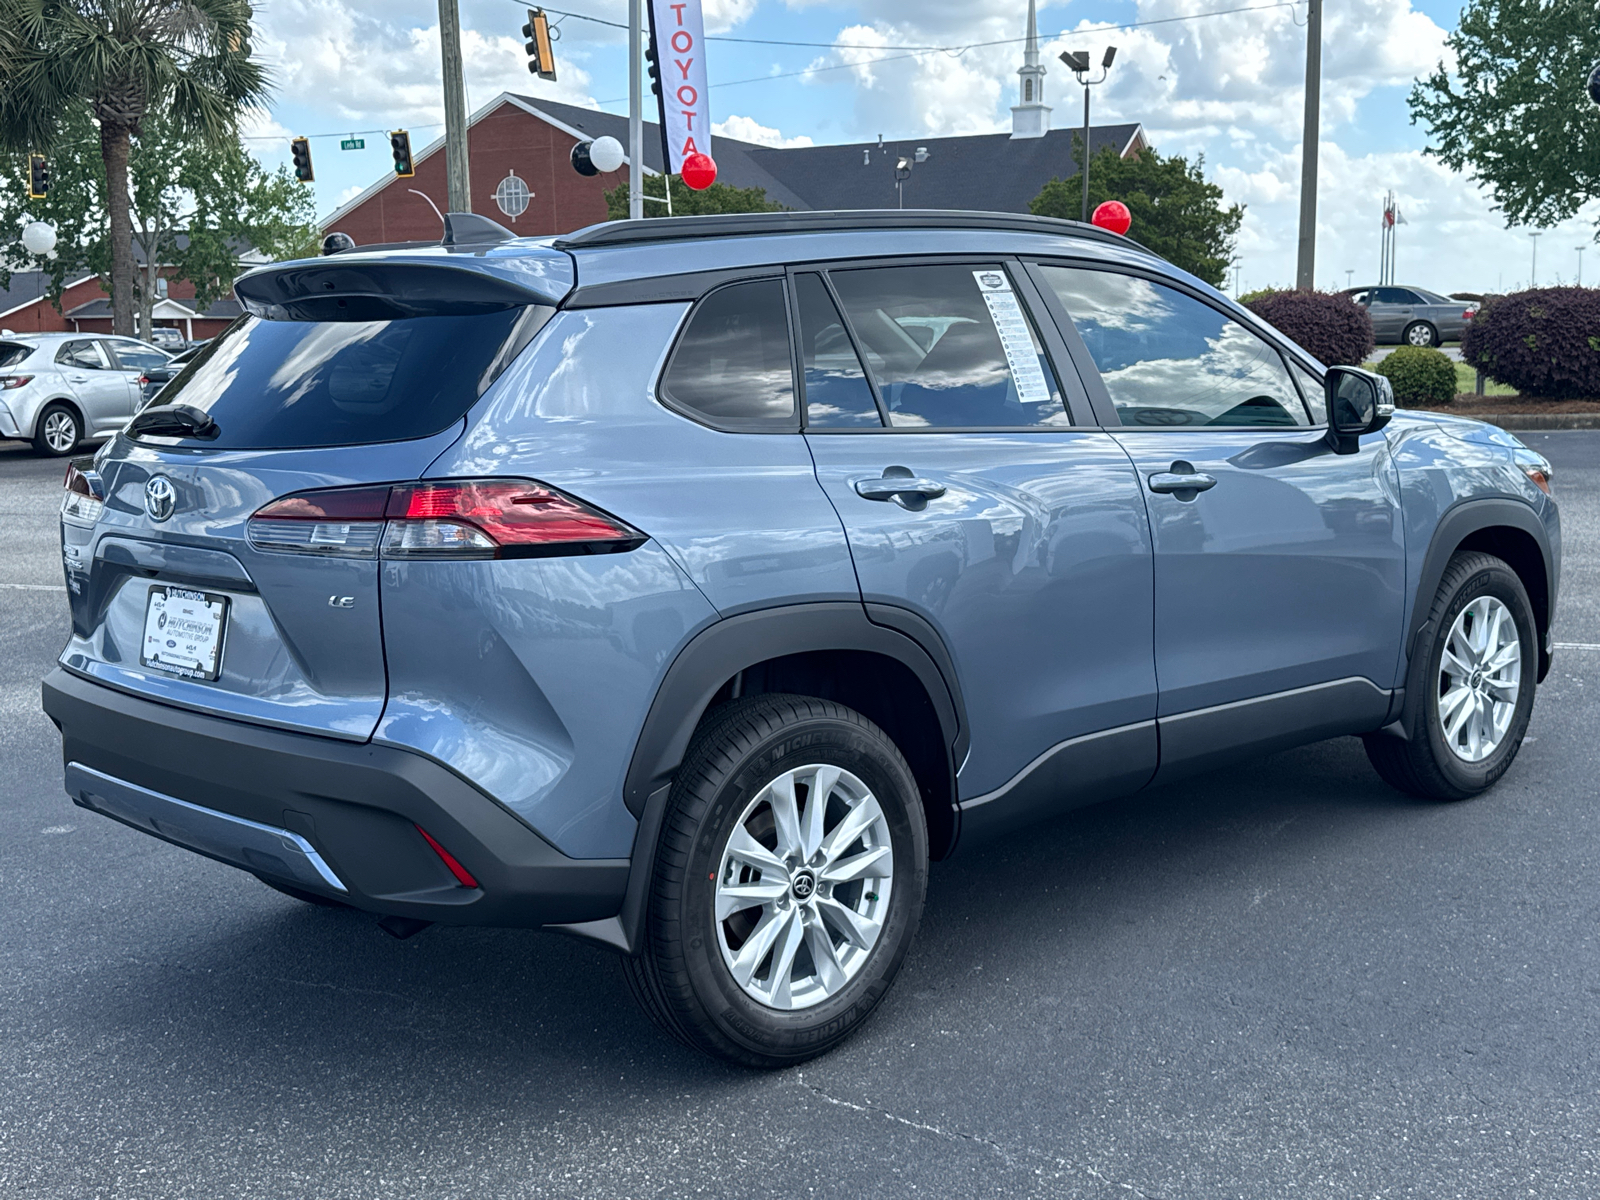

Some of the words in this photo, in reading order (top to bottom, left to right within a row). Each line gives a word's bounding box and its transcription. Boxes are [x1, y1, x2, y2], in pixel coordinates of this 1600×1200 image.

[670, 3, 698, 156] TOYOTA
[328, 595, 355, 609] LE
[771, 732, 848, 762] MICHELIN
[792, 1006, 857, 1043] MICHELI
